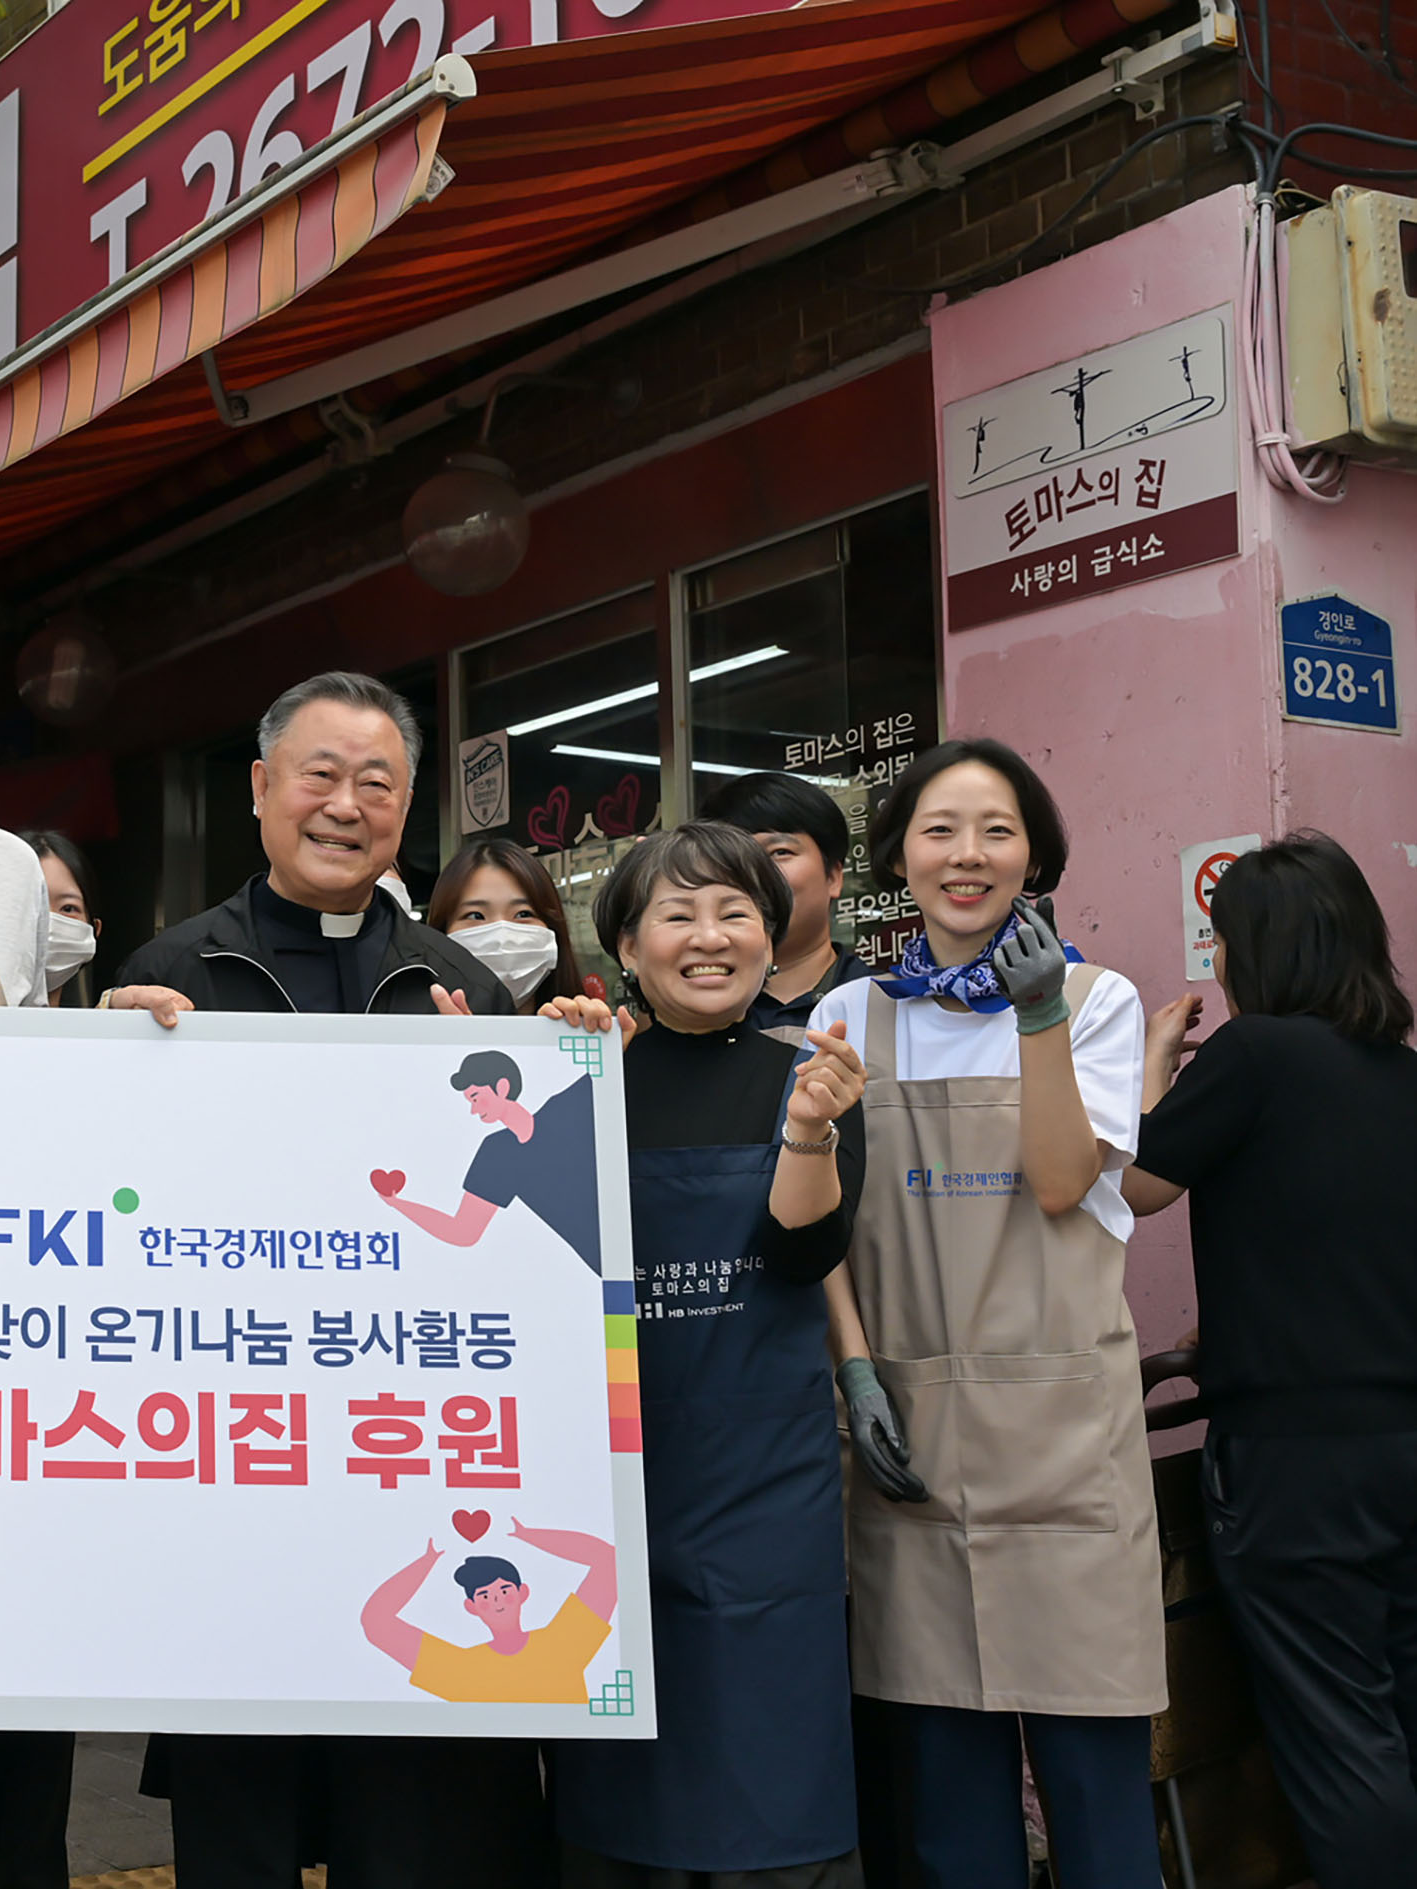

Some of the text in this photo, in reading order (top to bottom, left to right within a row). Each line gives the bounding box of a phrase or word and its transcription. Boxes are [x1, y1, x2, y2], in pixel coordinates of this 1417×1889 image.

[1004, 458, 1166, 552] 토마스의 집
[1010, 533, 1166, 597] 사랑의 급식소
[1318, 611, 1357, 633] 경인로
[1293, 656, 1386, 708] 828-1
[783, 712, 916, 771] 토마스의 집은
[139, 1226, 401, 1271] 한국경제인협회
[653, 1261, 698, 1279] 사랑과
[652, 1276, 729, 1296] 토마스의 집
[85, 1306, 291, 1366] 온기나눔
[308, 1309, 517, 1370] 봉사활동
[668, 1308, 685, 1318] HB
[346, 1392, 522, 1490] 후원
